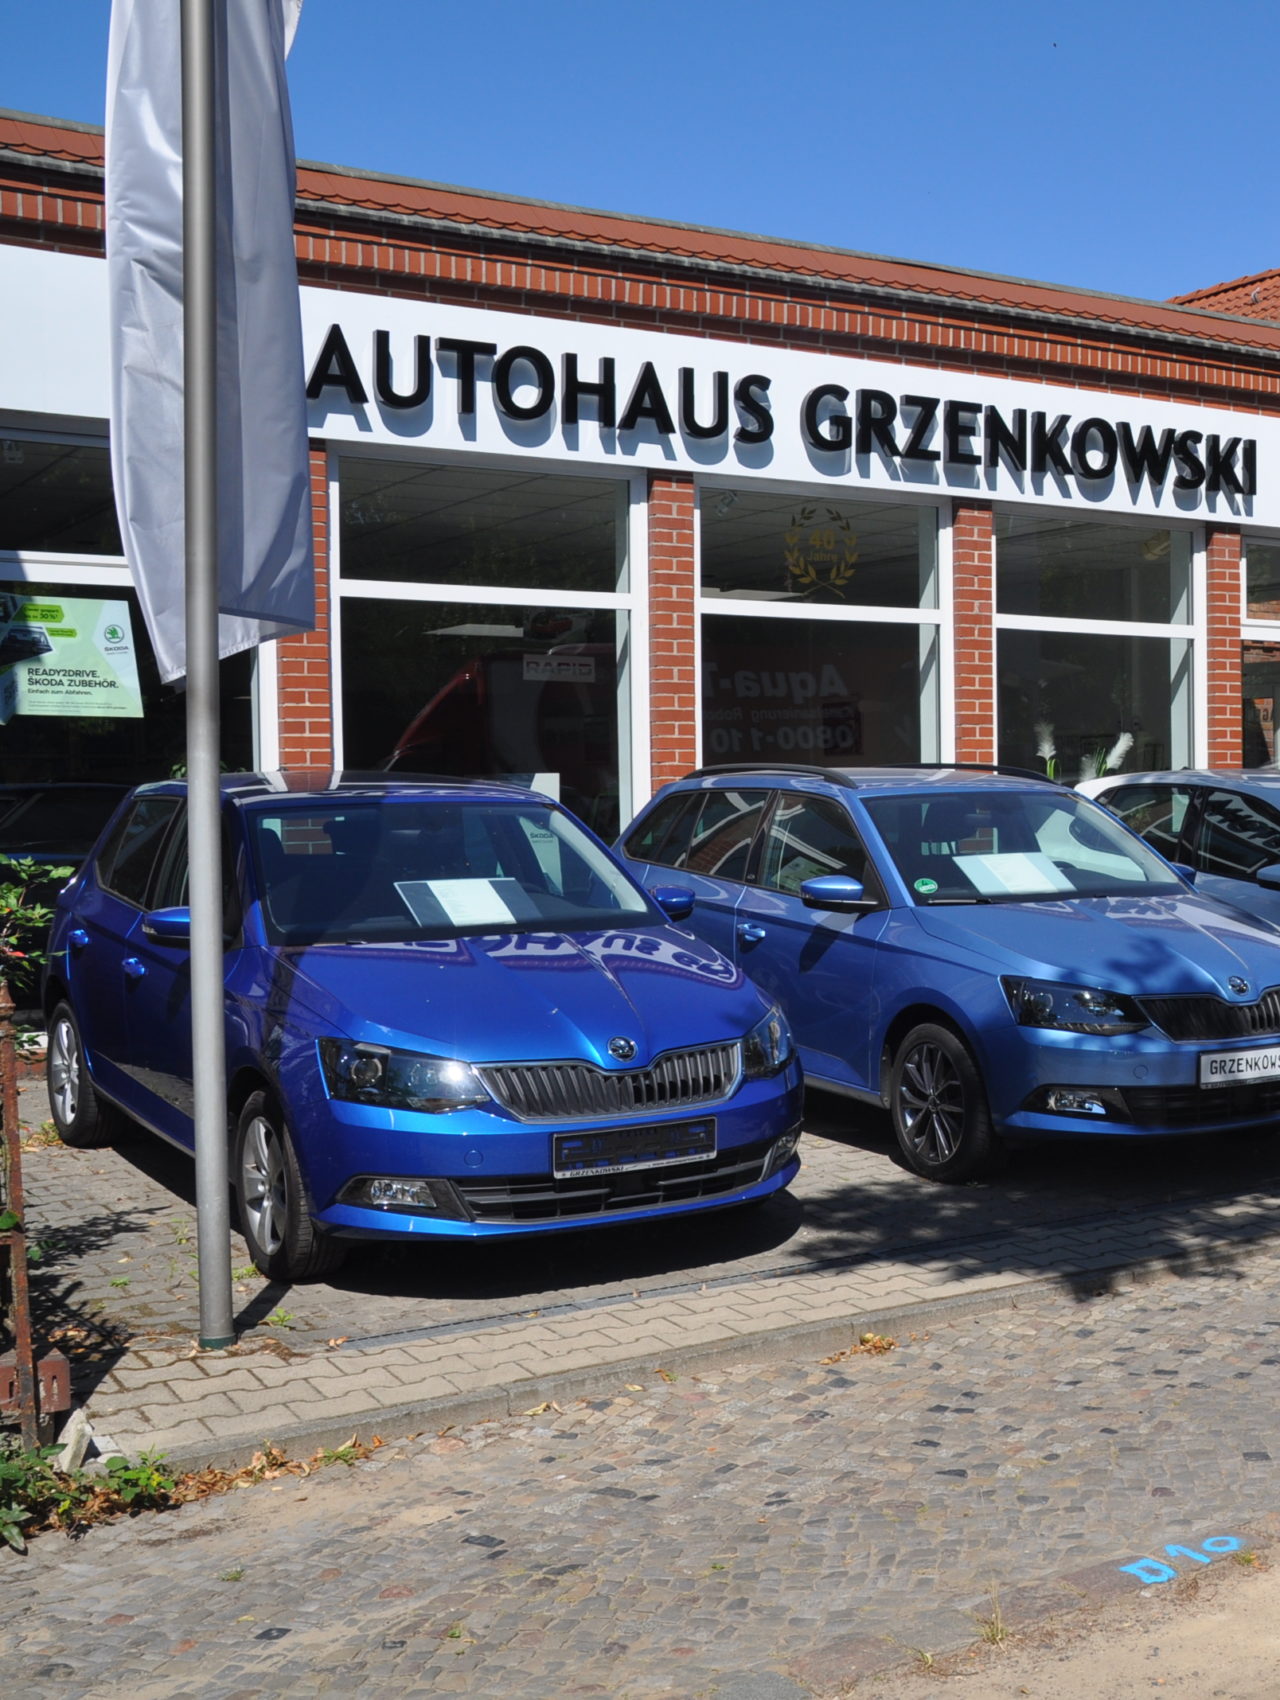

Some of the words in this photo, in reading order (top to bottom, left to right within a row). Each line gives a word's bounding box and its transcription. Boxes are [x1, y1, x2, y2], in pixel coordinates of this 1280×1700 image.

[305, 323, 775, 443] AUTOHAUS
[799, 383, 1257, 496] GRZENKOWSKI
[809, 528, 836, 550] 40
[27, 668, 100, 678] READY2DRIVE.
[526, 661, 592, 675] RAPID
[27, 676, 65, 687] ŠKODA
[68, 678, 119, 689] ZUBEHÖR.
